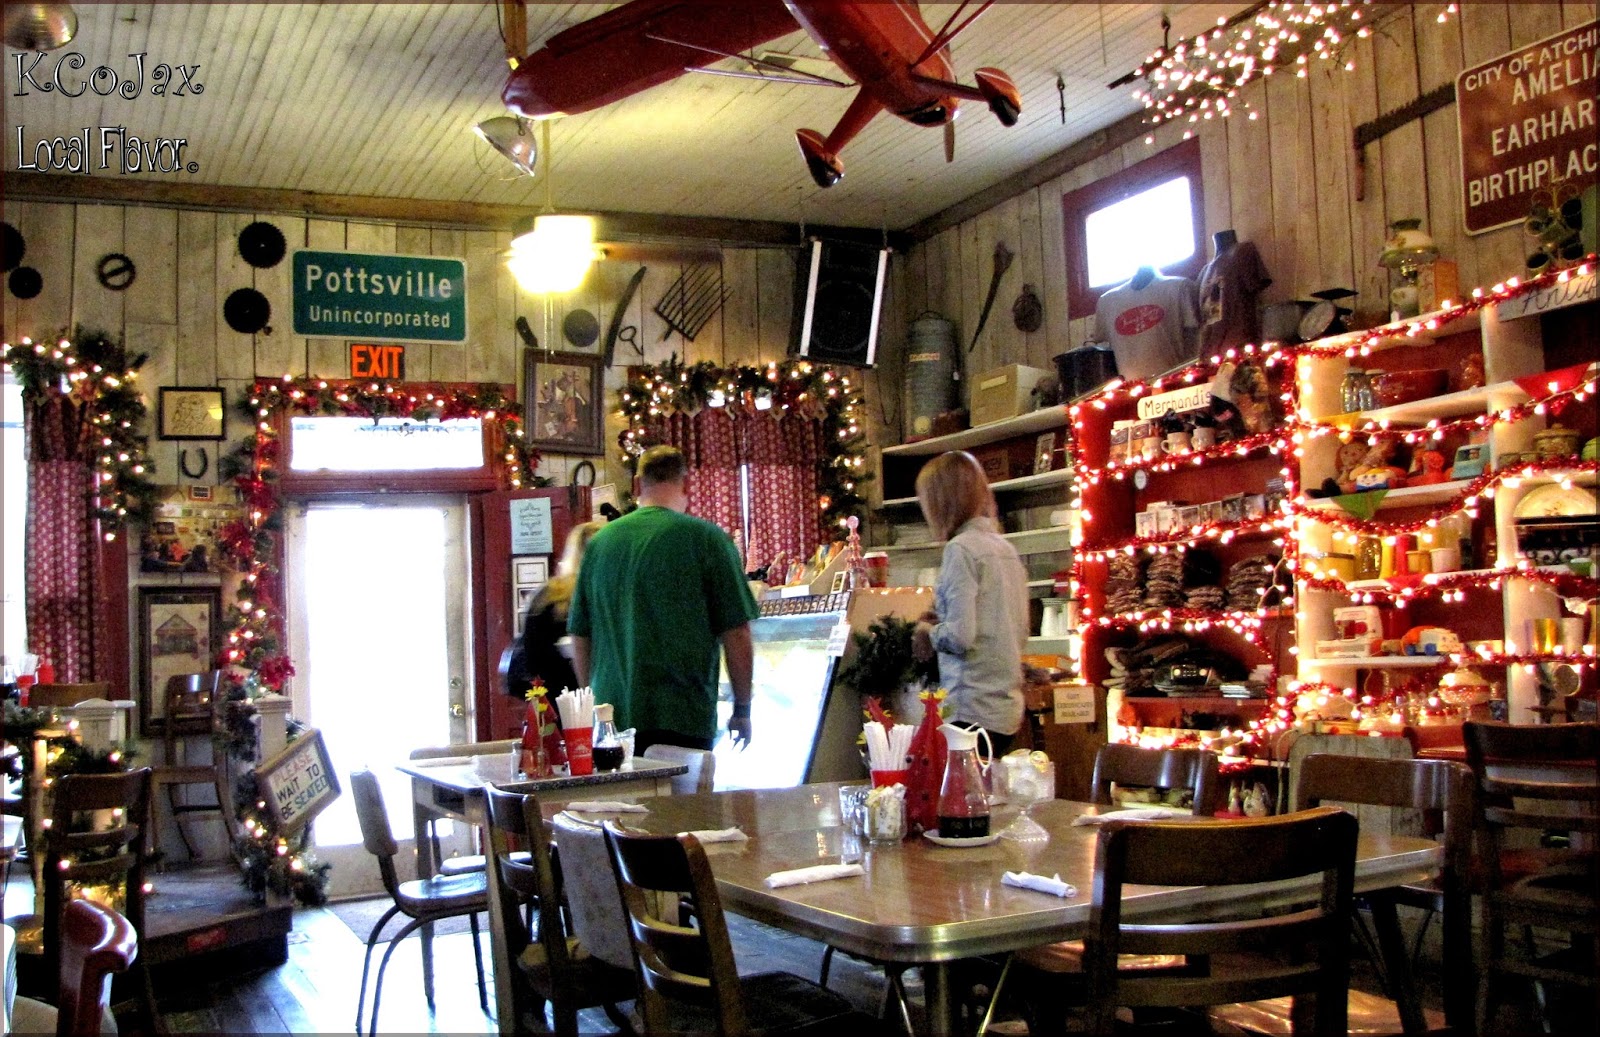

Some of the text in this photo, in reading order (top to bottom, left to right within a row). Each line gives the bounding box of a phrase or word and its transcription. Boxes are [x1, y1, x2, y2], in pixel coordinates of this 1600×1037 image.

[1465, 28, 1600, 92] CITY OF ATCHI
[1491, 95, 1600, 156] EARHAR
[1468, 143, 1600, 207] BIRTHPLAC
[306, 264, 451, 299] Pottsville
[309, 305, 450, 328] Unincorporated
[351, 345, 404, 379] EXIT
[1144, 390, 1211, 418] Merchandis
[272, 751, 314, 787] PLEASE
[276, 763, 320, 803] WAIT TO
[280, 774, 329, 821] BE SEATED
